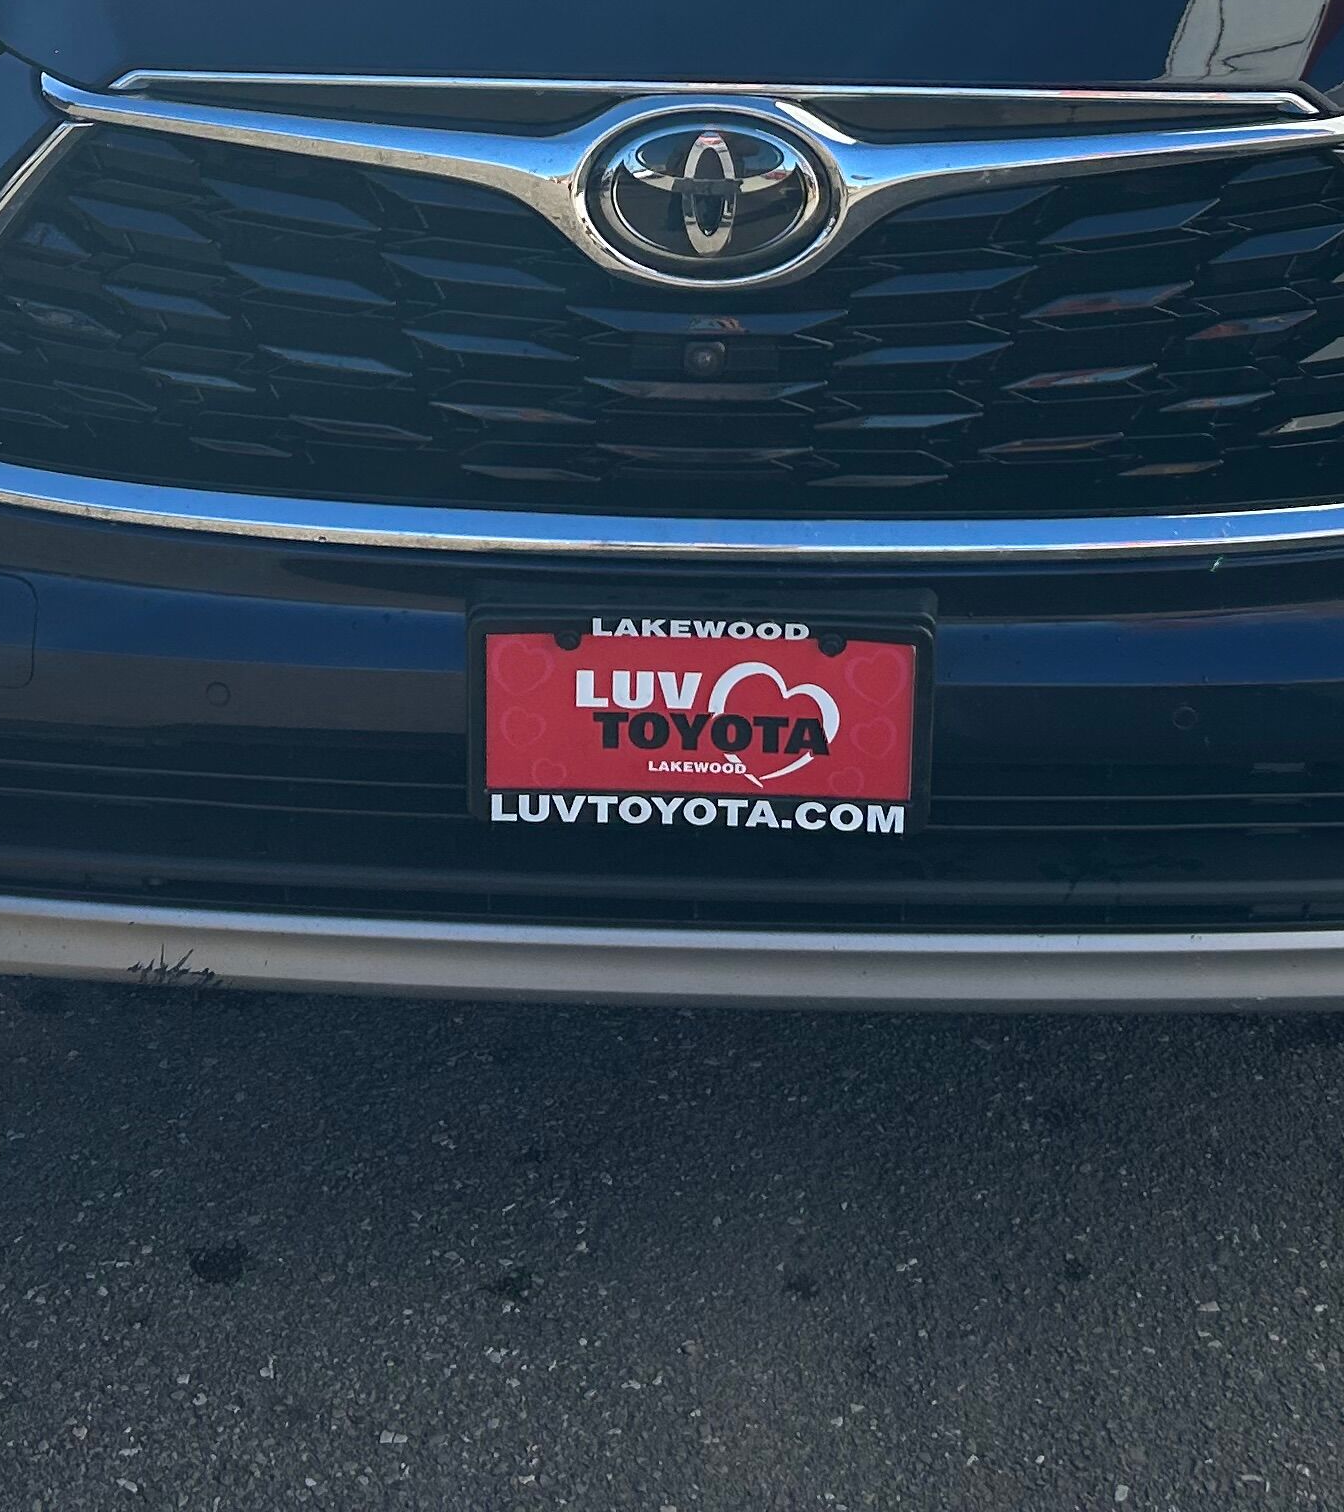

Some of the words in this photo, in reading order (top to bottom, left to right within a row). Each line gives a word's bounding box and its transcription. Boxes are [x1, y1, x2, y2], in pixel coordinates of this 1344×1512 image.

[591, 616, 811, 641] LAKEWOOD
[575, 668, 703, 710] LUV
[592, 711, 831, 756] TOYOTA
[647, 759, 747, 776] LAKEWOOD
[489, 793, 906, 835] LUVTOYOTA.COM
